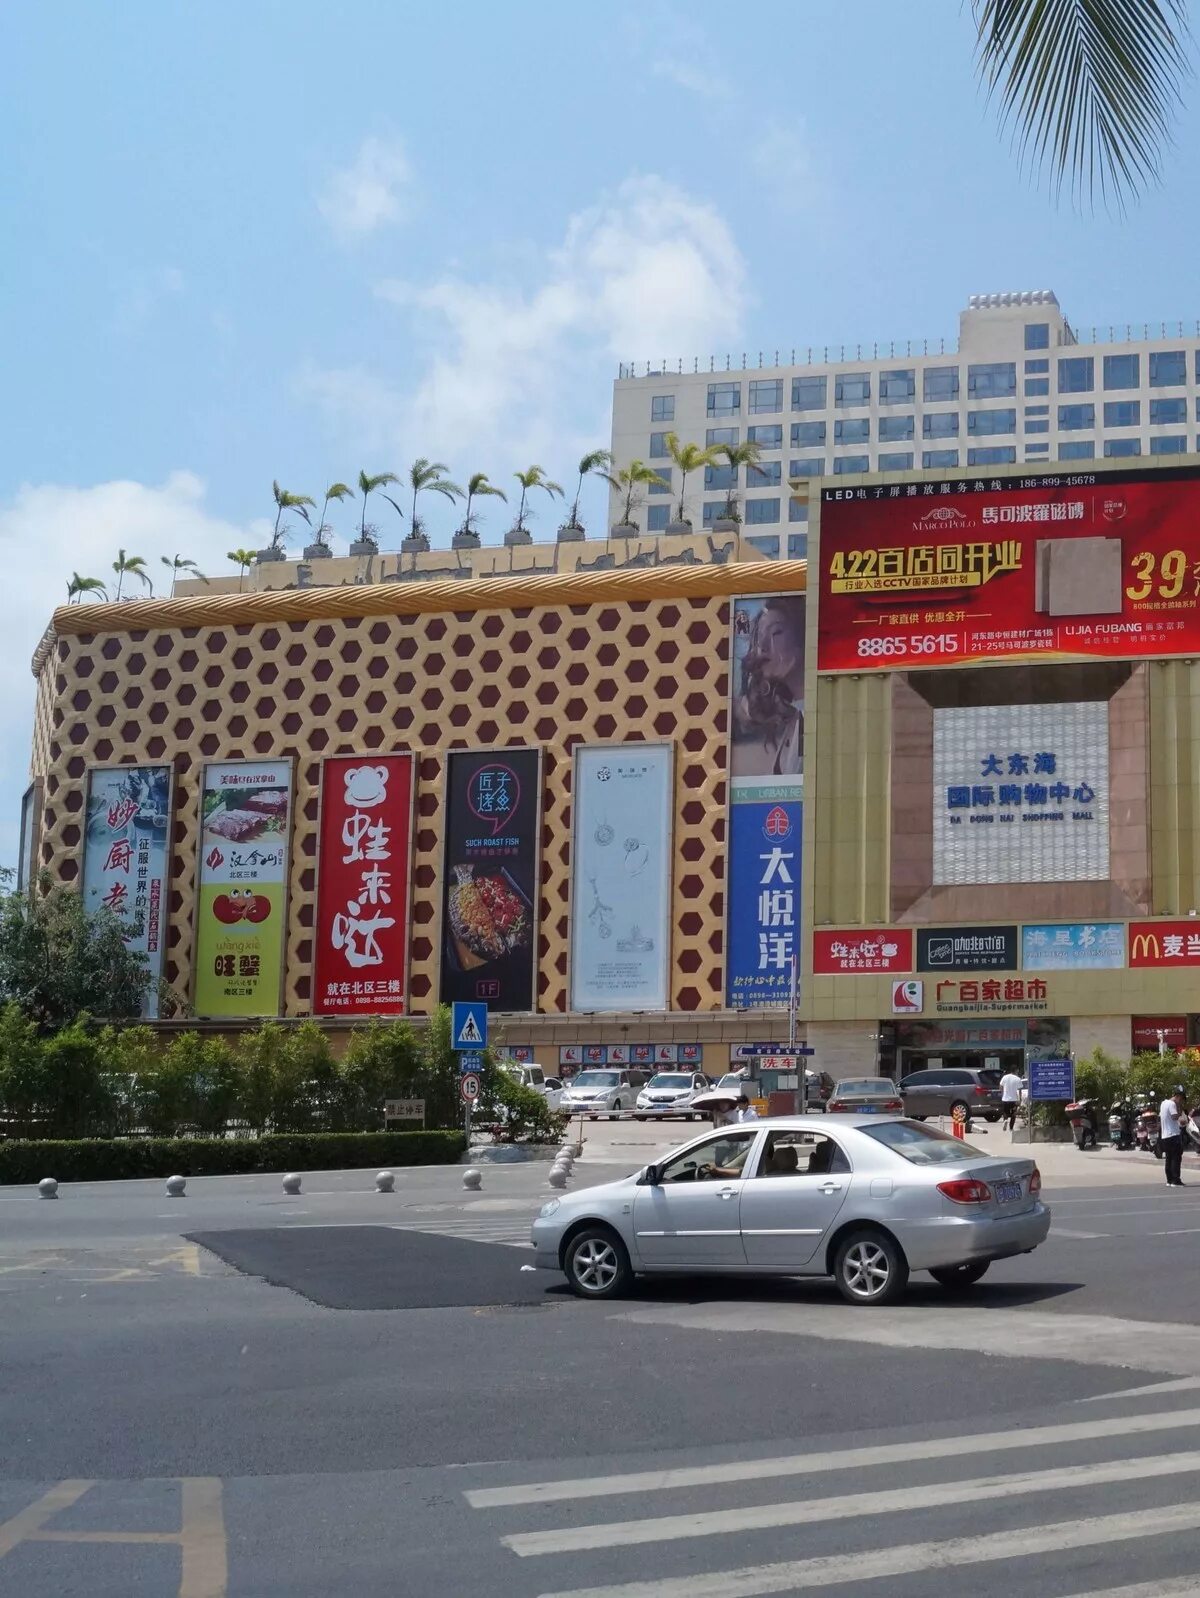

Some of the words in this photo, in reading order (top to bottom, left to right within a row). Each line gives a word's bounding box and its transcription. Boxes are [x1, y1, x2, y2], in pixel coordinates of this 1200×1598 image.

[1126, 550, 1187, 600] 39
[878, 613, 920, 626] 厂家直供
[1095, 623, 1142, 634] FUBANG
[858, 636, 907, 657] 8865
[911, 633, 958, 654] 5615
[980, 752, 1056, 776] 大东海
[947, 781, 1095, 808] 国际购物中心
[465, 839, 482, 847] SUCH
[483, 838, 503, 847] ROAST
[506, 837, 520, 845] FISH
[229, 871, 258, 879] 北区三楼
[332, 810, 396, 968] 蛙来哒
[758, 848, 795, 969] 大悦洋
[215, 954, 260, 977] 旺蟹
[840, 959, 890, 968] 就在北区三楼
[327, 980, 401, 996] 就在北区三楼
[936, 978, 1047, 1001] 广百家超市
[936, 1003, 1047, 1013] Guangbaijia-Supermarket
[763, 1056, 795, 1068] 洗车
[466, 1081, 476, 1094] 15
